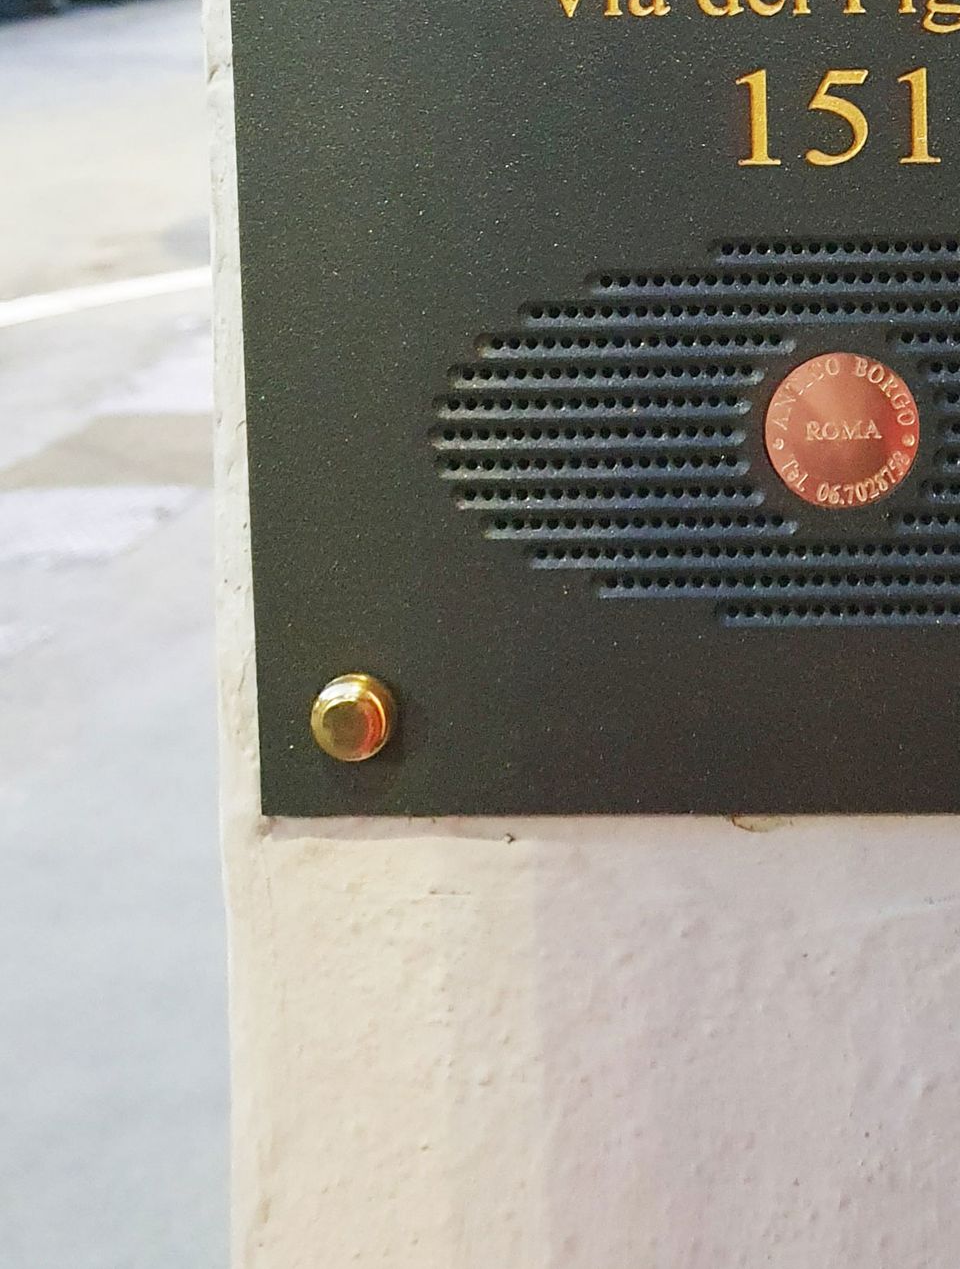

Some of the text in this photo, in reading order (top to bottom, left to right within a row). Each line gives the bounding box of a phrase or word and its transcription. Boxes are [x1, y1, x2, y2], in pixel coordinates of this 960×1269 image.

[735, 67, 942, 166] 151
[854, 356, 916, 427] BORGO
[805, 419, 882, 441] ROMA
